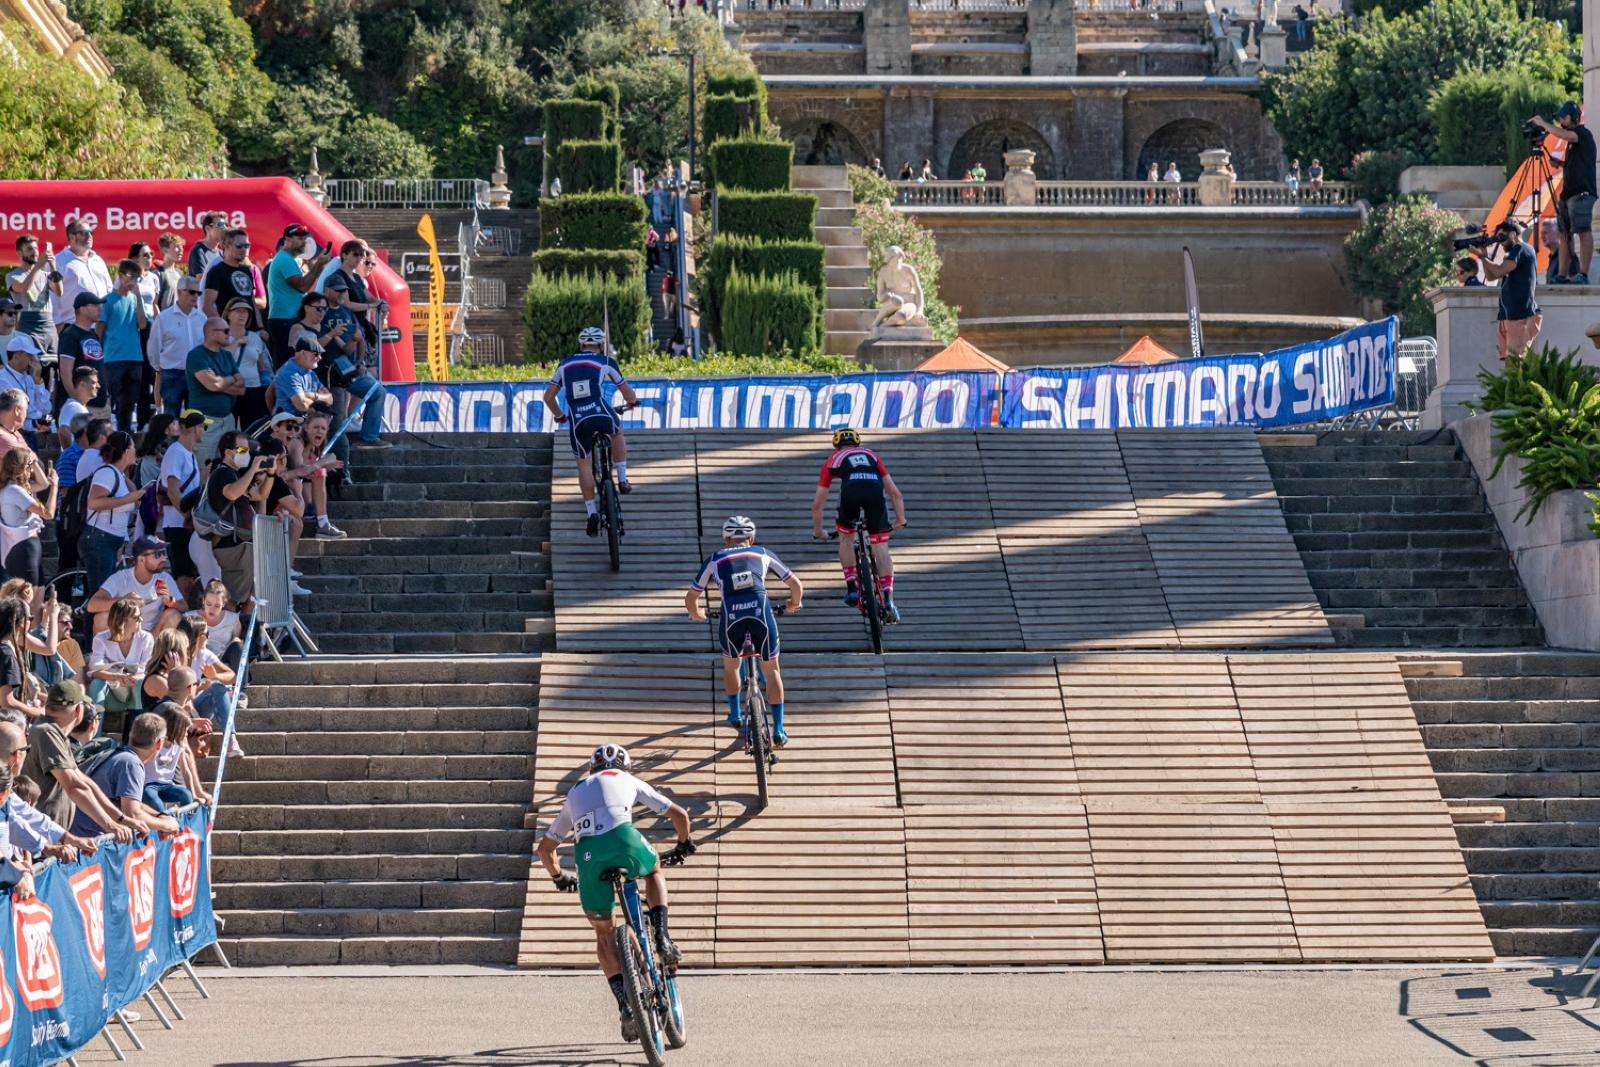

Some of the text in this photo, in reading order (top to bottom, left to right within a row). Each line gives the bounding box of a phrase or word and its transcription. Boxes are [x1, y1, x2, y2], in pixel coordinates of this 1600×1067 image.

[106, 206, 247, 231] Barceloa
[1293, 335, 1387, 414] SHIMANO
[578, 384, 585, 392] 3
[1022, 360, 1281, 428] SHIMANO
[612, 379, 970, 429] SHIMANO
[849, 472, 878, 480] AUSTRIA
[736, 573, 748, 582] 19
[735, 600, 758, 611] FRANCE
[576, 818, 591, 833] 30
